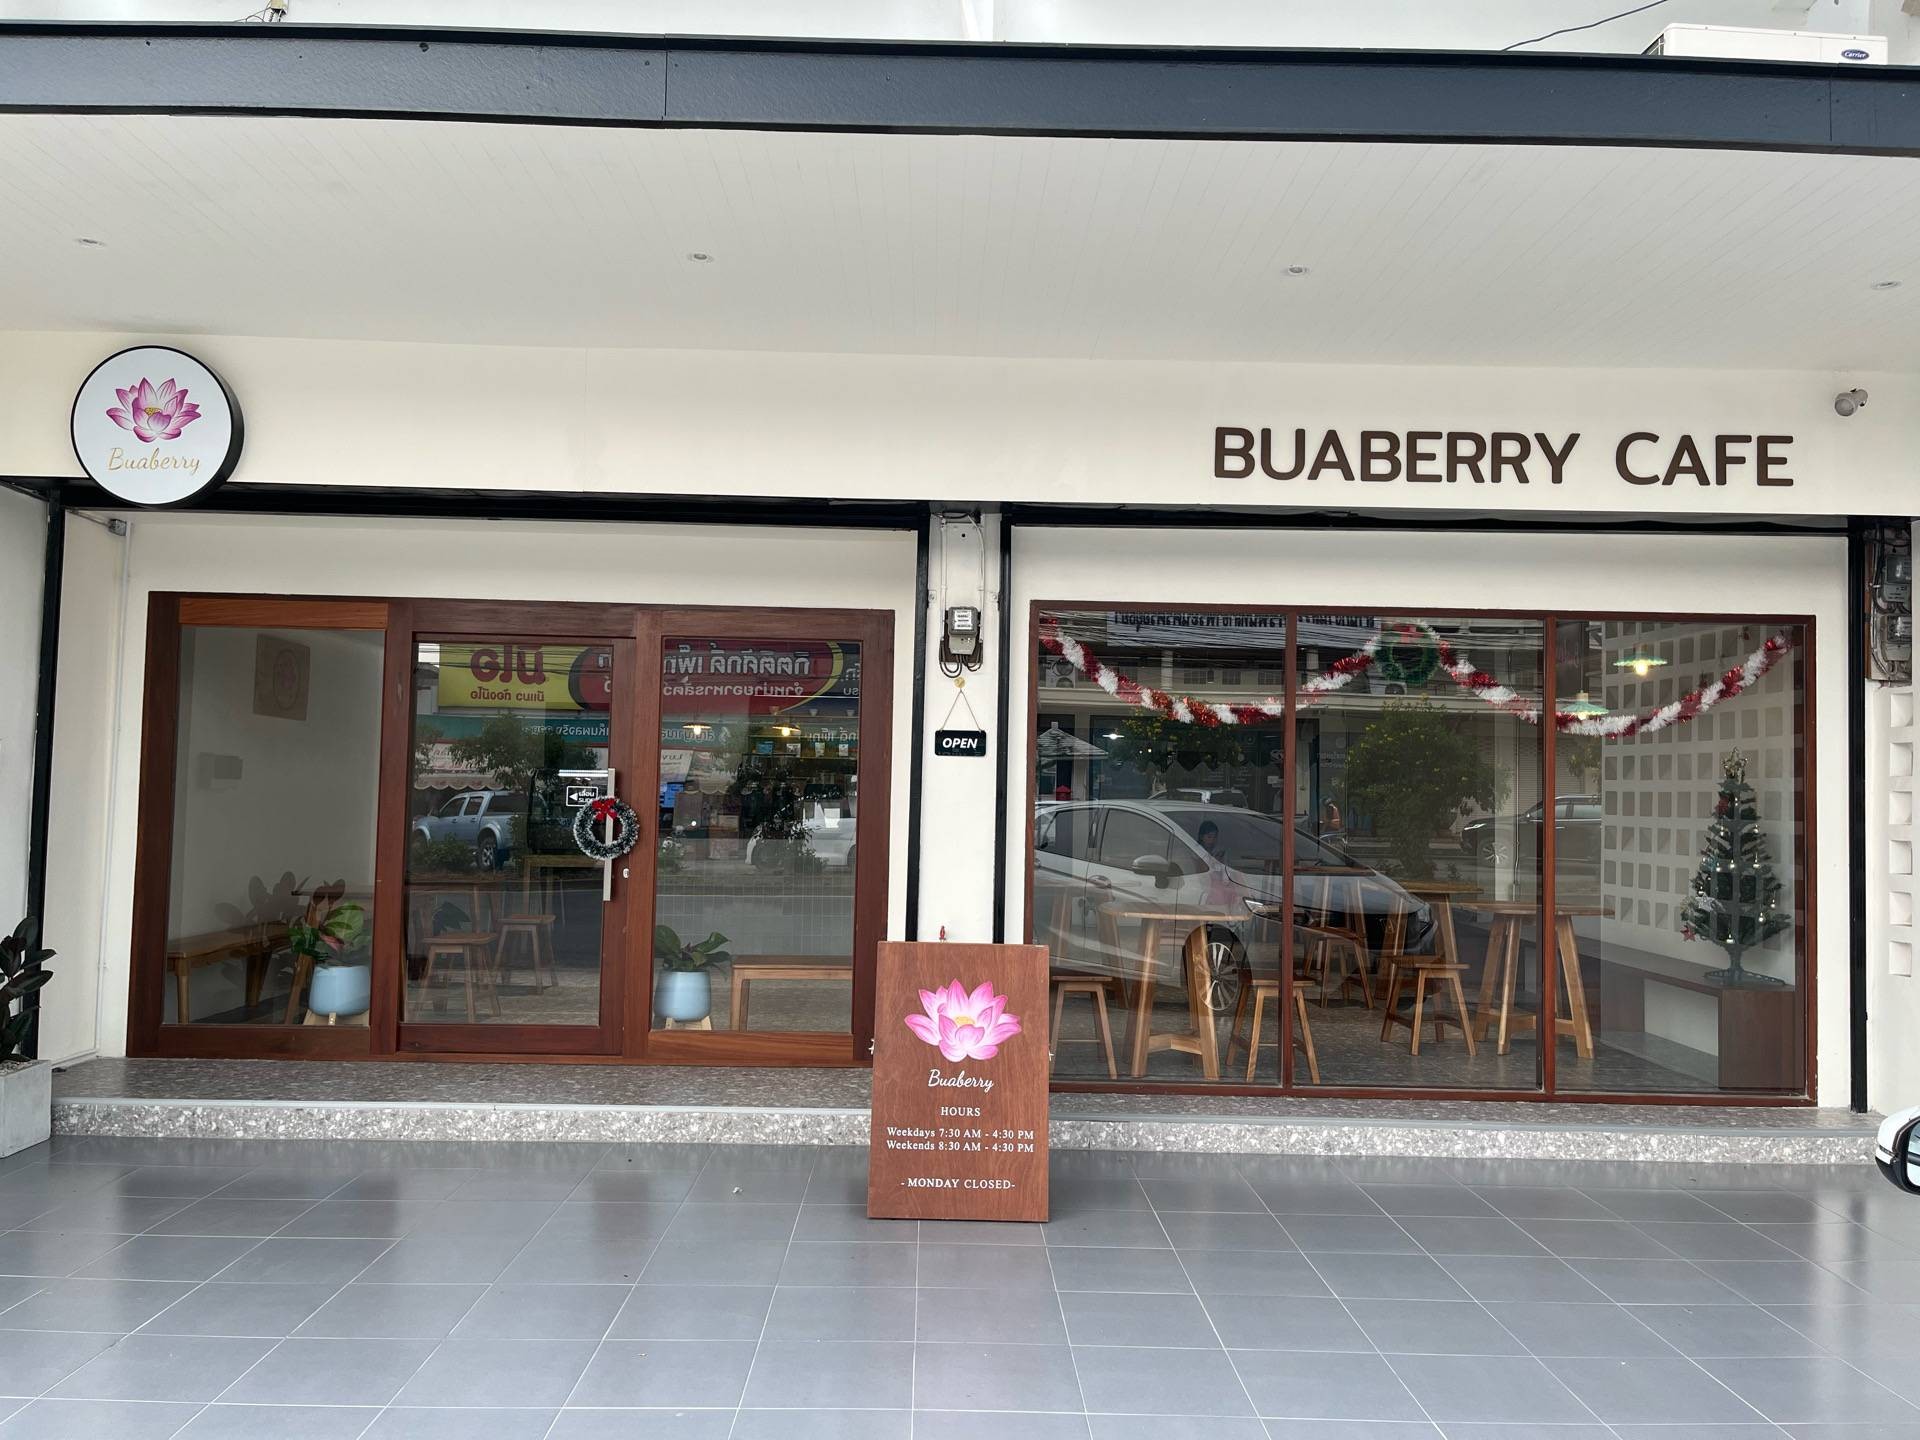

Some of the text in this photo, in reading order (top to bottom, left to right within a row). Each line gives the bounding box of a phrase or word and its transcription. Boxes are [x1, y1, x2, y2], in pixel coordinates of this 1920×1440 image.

[108, 447, 201, 475] Buaberry
[1215, 427, 1793, 486] BUABERRY CAFE
[942, 737, 978, 749] OPEN
[928, 1069, 994, 1092] Buaberry
[941, 1107, 981, 1117] HOURS
[887, 1127, 935, 1138] Weekdays
[939, 1128, 960, 1138] 7:30
[963, 1129, 981, 1139] AM
[992, 1129, 1014, 1140] 4:30
[1017, 1130, 1034, 1140] PM
[887, 1140, 935, 1151] Weekends
[938, 1141, 960, 1151] 8:30
[963, 1142, 981, 1152] AM
[992, 1142, 1014, 1153] 4:30
[1017, 1143, 1034, 1153] PM
